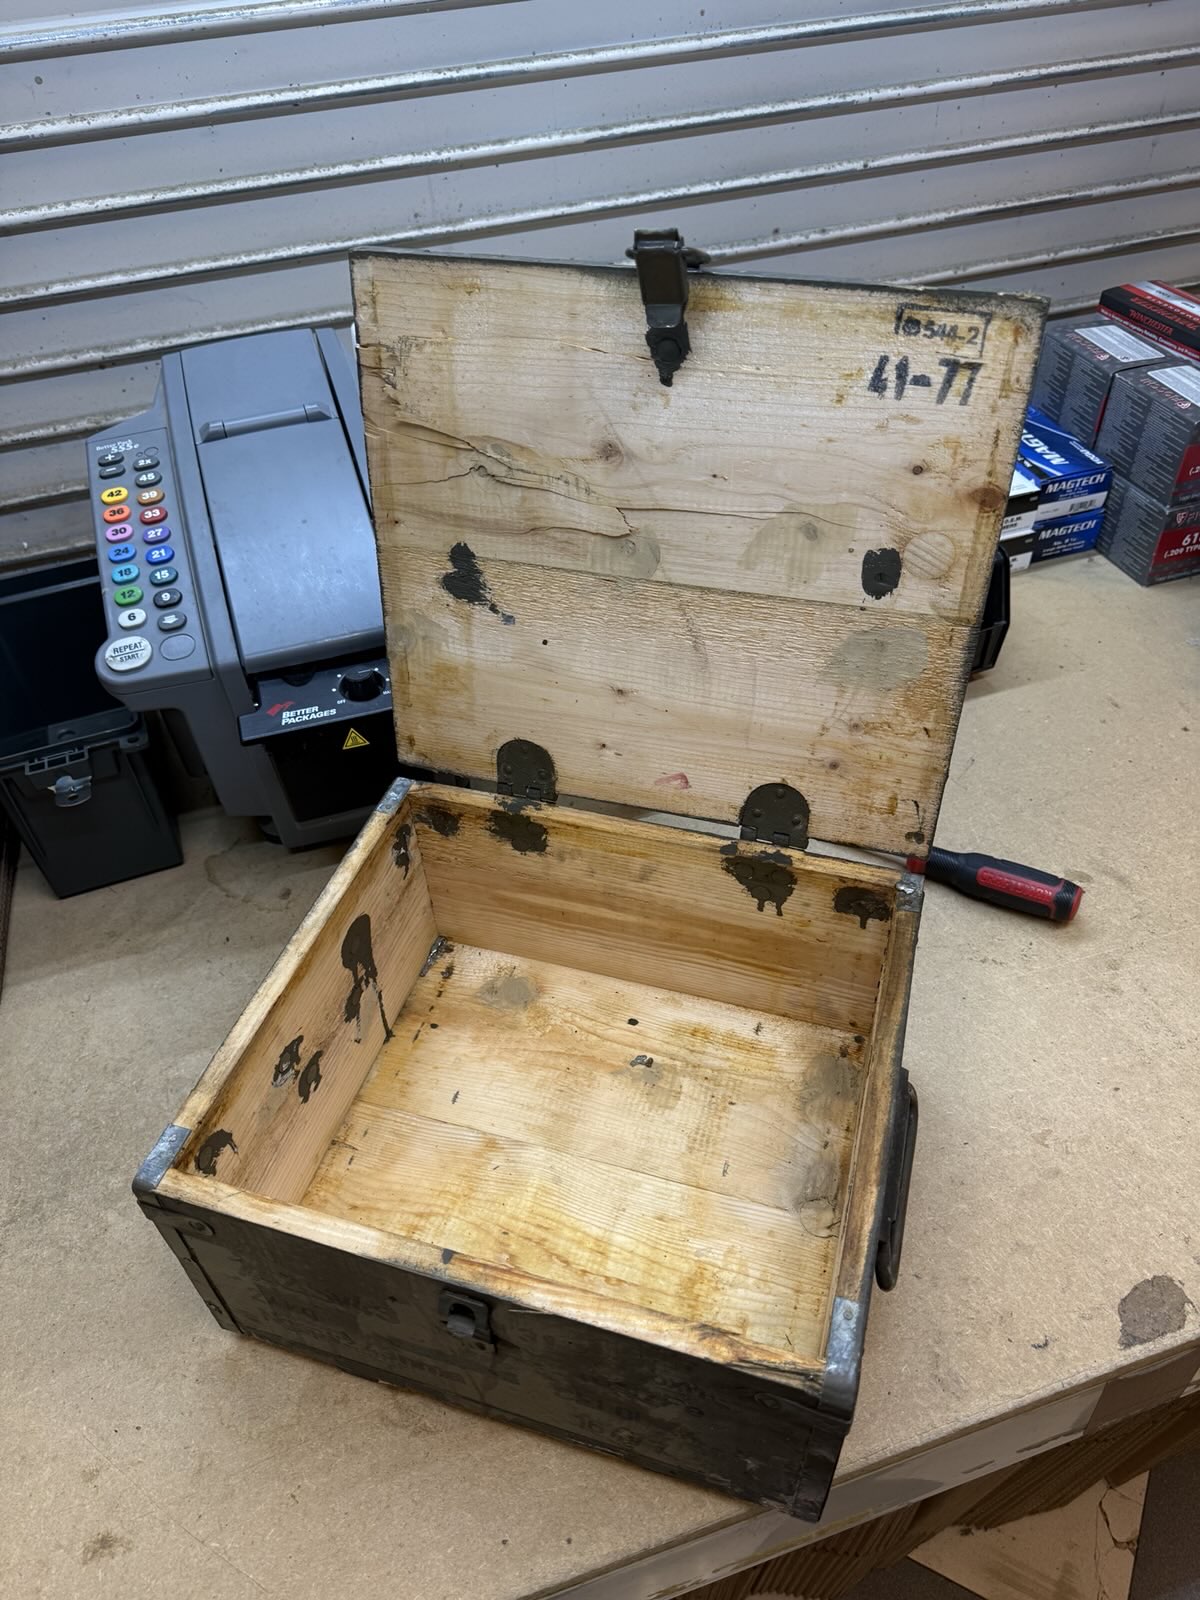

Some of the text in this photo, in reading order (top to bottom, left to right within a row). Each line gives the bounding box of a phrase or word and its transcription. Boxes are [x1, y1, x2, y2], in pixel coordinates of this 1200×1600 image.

[139, 473, 155, 482] 45
[1045, 473, 1106, 495] MAGTECH
[107, 489, 122, 497] 42
[141, 490, 158, 500] 39
[109, 507, 124, 517] 36
[144, 508, 160, 519] 33
[111, 527, 127, 536] 30
[147, 528, 163, 539] 27
[1039, 520, 1097, 541] MAGTECH
[1181, 532, 1200, 547] 61
[114, 547, 129, 557] 24
[151, 548, 166, 559] 21
[117, 568, 132, 577] 18
[154, 569, 169, 580] 15
[120, 590, 135, 599] 12
[161, 592, 171, 601] 9
[127, 612, 137, 622] 6
[113, 641, 144, 655] REPEAT
[119, 652, 140, 663] START
[281, 708, 337, 726] PACKAGES
[282, 706, 319, 719] BETTER
